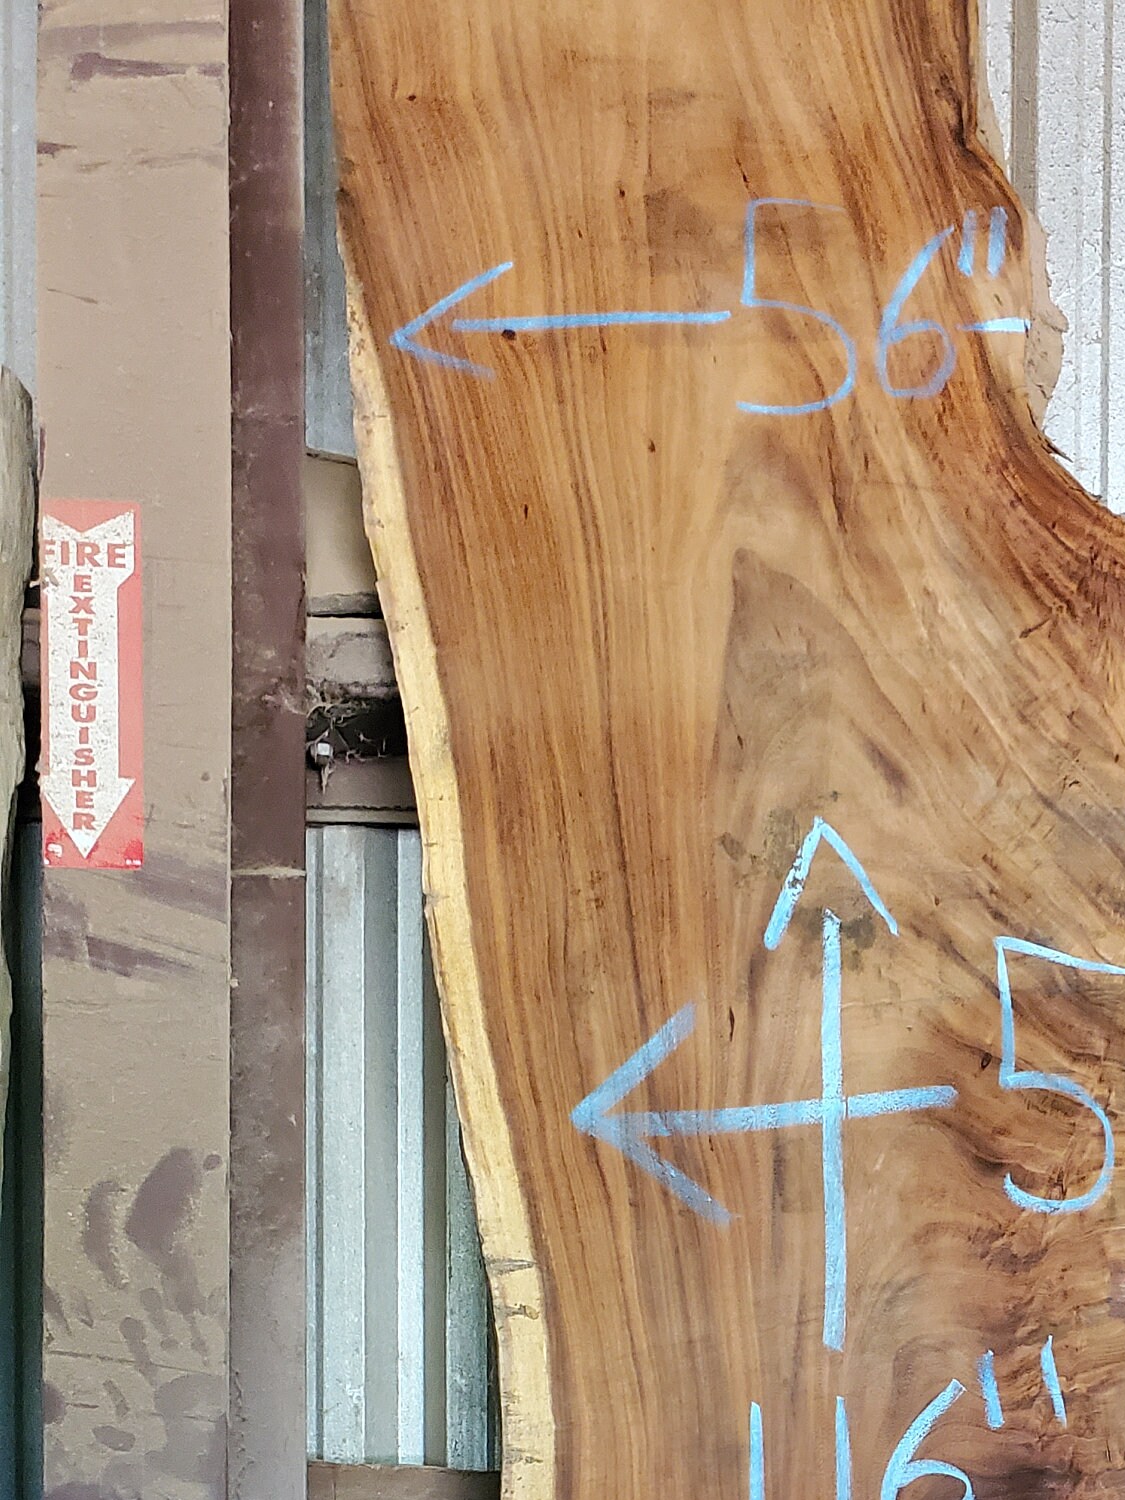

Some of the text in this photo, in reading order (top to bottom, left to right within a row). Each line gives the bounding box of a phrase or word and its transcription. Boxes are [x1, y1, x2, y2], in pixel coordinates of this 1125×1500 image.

[737, 198, 1006, 415] 56"
[43, 539, 126, 568] FIRE
[69, 574, 98, 830] EXTINGUISHER
